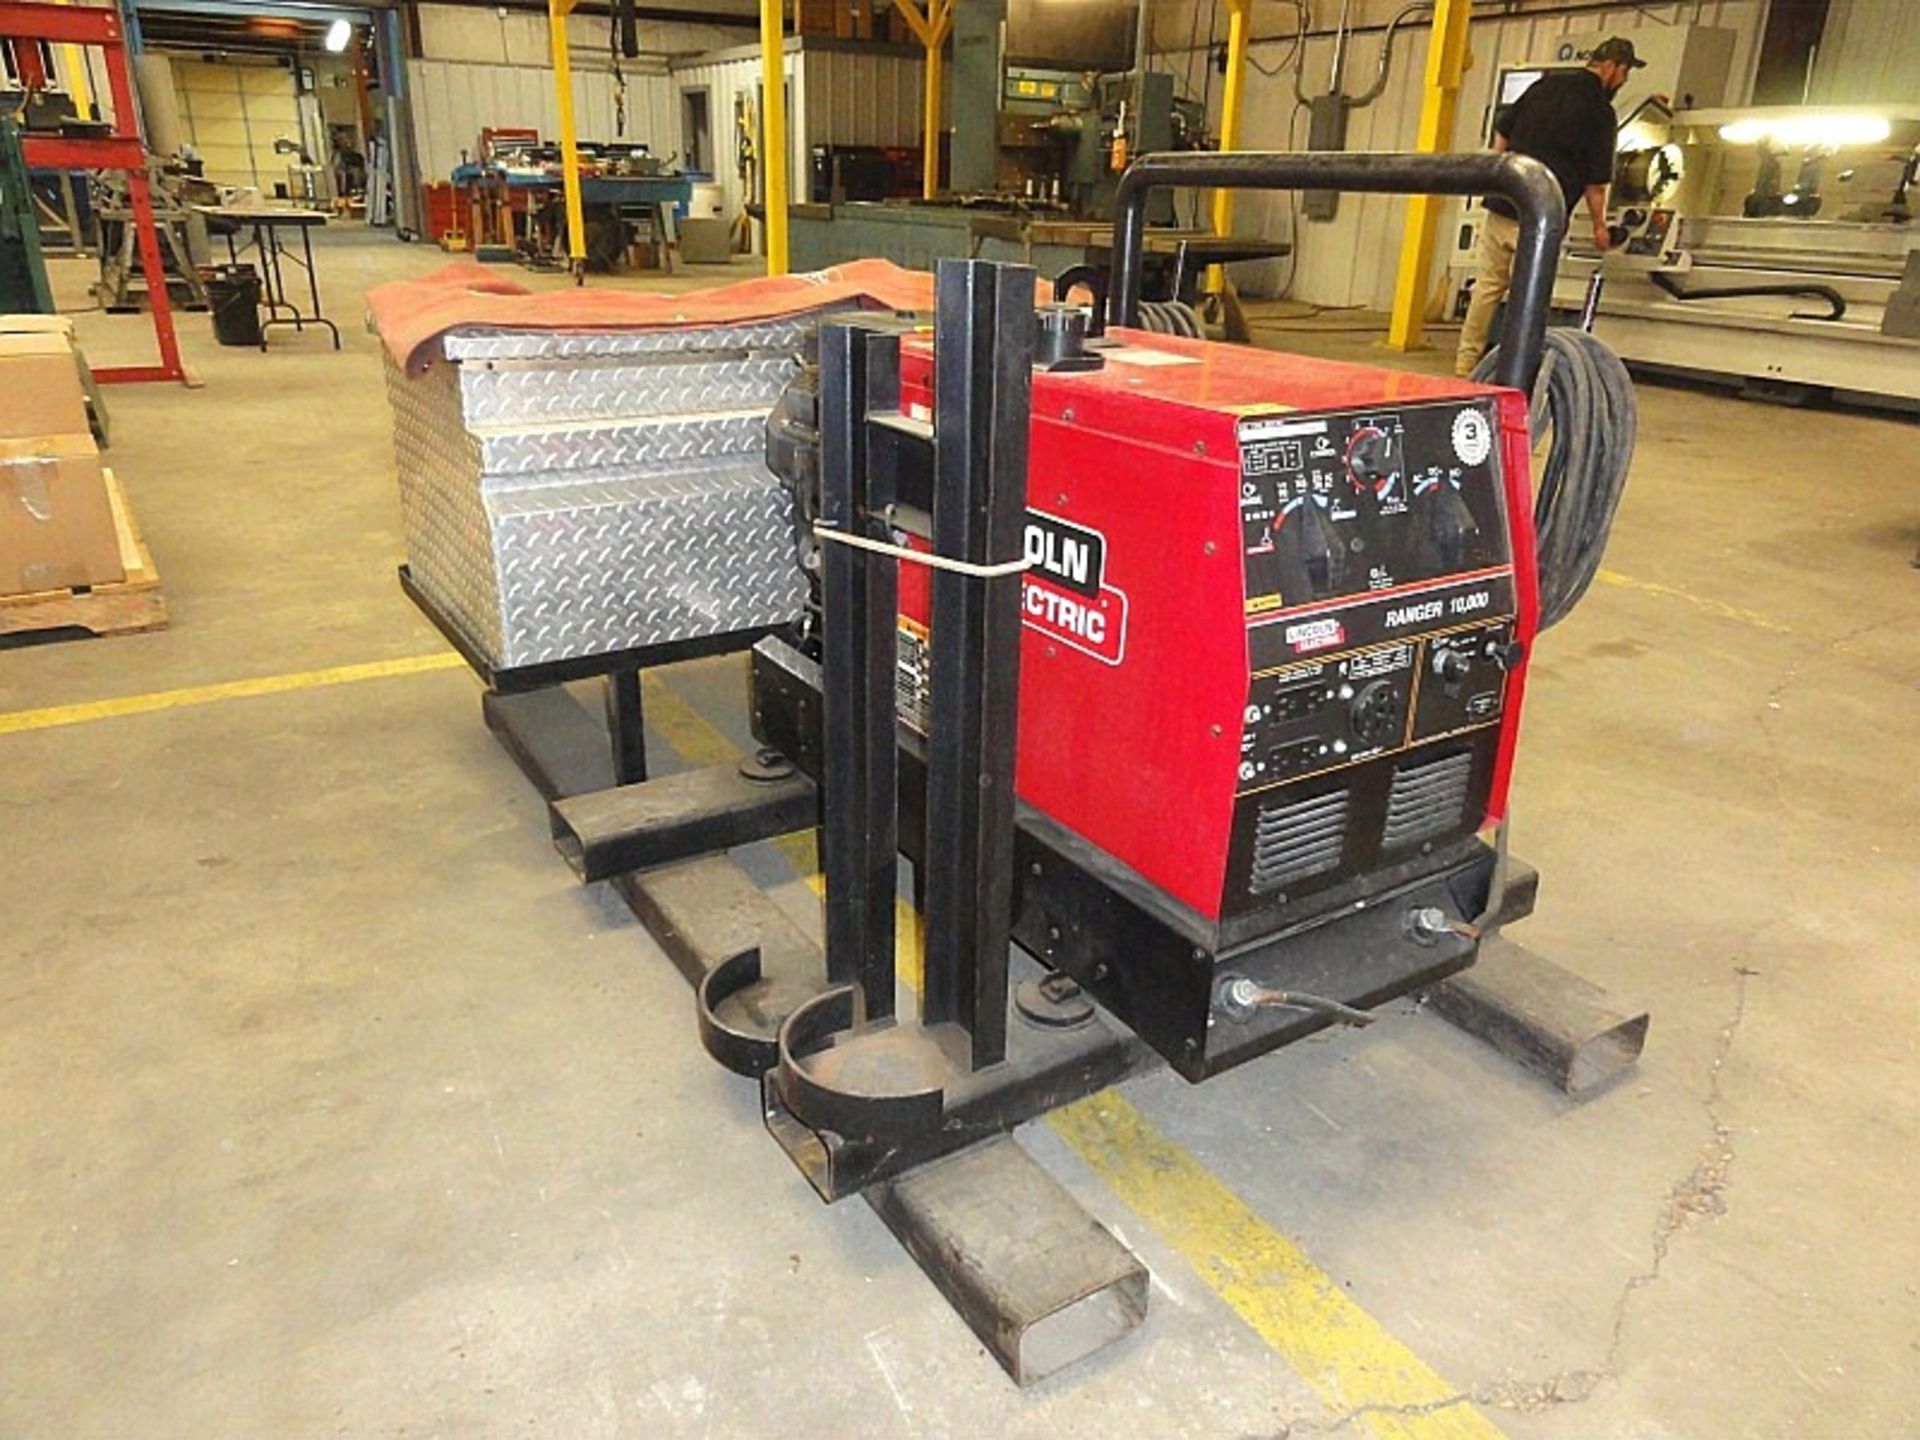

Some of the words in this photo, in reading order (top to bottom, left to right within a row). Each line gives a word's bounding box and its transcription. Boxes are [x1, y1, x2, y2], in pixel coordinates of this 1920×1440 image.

[1463, 422, 1478, 440] 3
[1022, 580, 1106, 644] CTRIC
[1384, 601, 1443, 627] RANGER
[1450, 592, 1489, 614] 10,000
